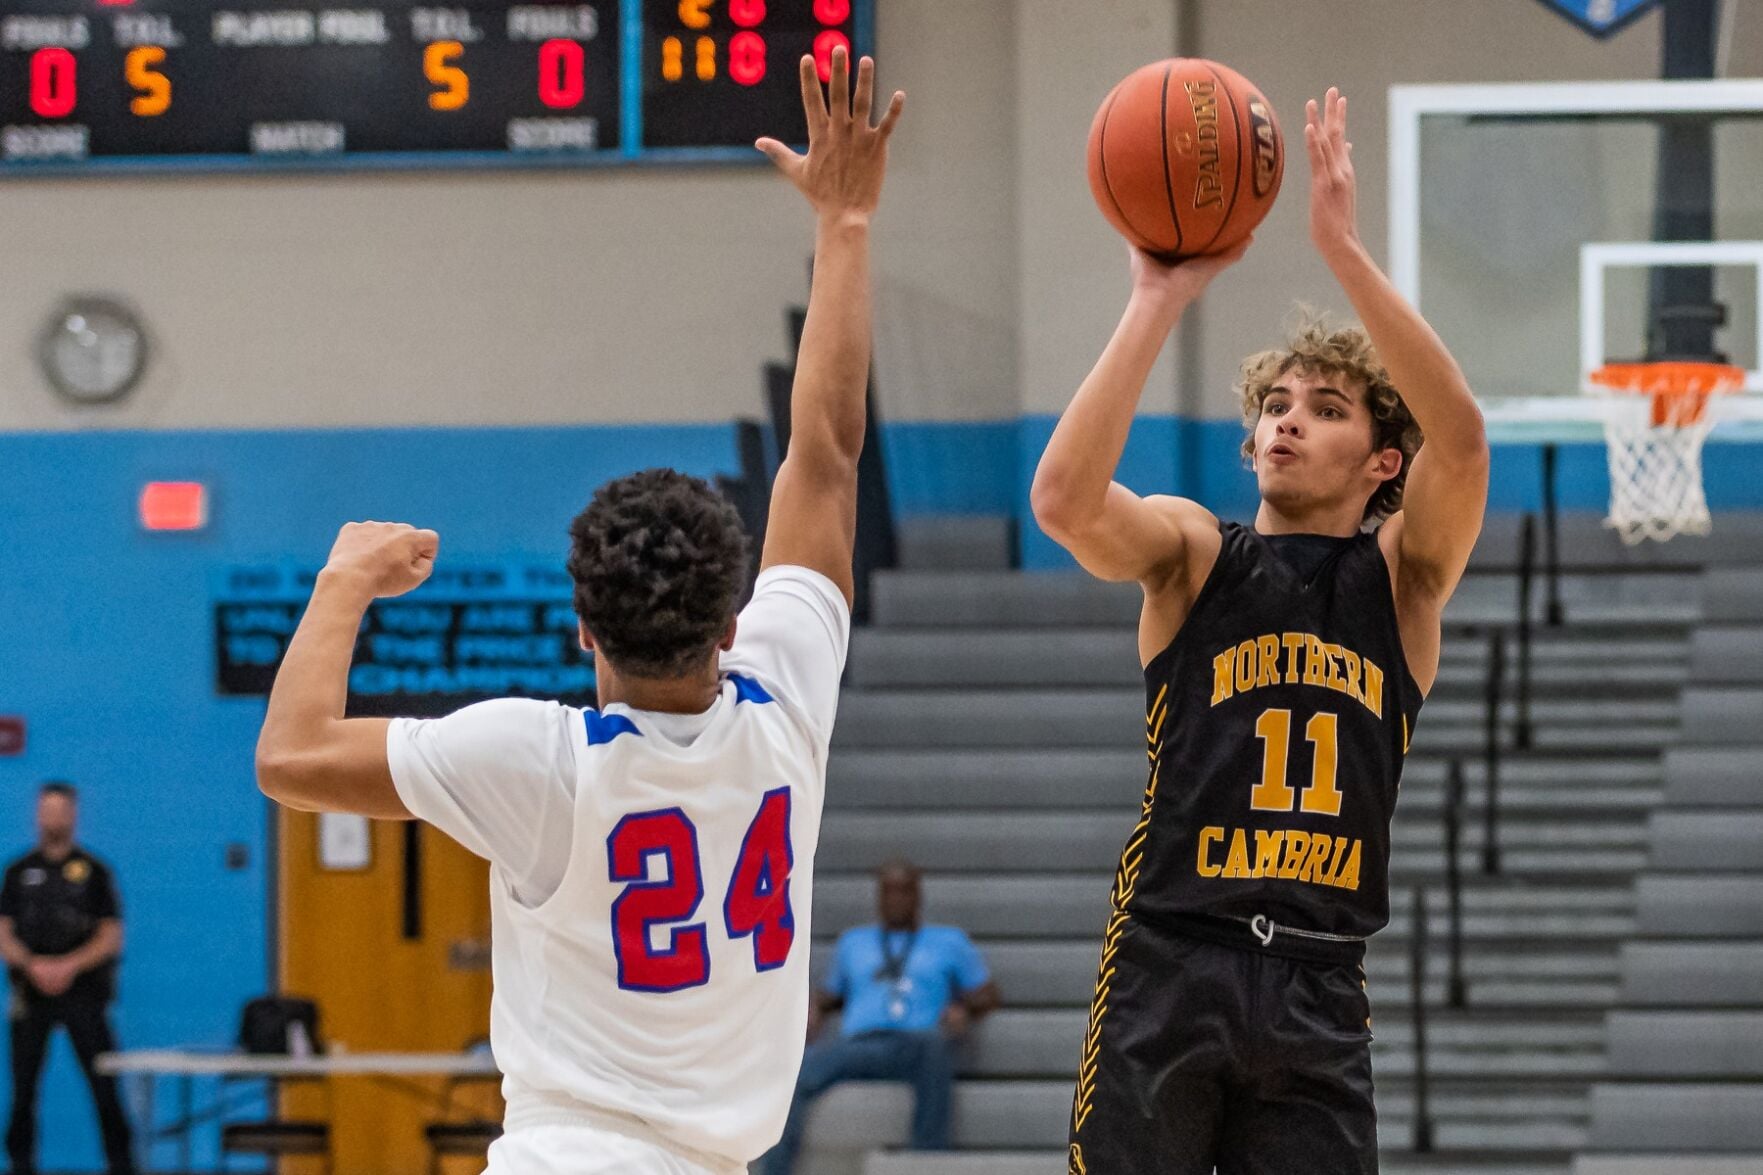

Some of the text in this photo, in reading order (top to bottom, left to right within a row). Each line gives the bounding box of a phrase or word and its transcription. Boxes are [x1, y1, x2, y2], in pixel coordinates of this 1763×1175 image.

[30, 47, 77, 118] 0
[125, 45, 171, 117] 5
[423, 40, 469, 111] 5
[538, 38, 584, 109] 0
[1184, 80, 1225, 209] SPALDING
[1211, 632, 1384, 720] NORTHERN
[1251, 708, 1342, 816] 11
[606, 785, 795, 993] 24
[1197, 826, 1362, 890] CAMBRIA
